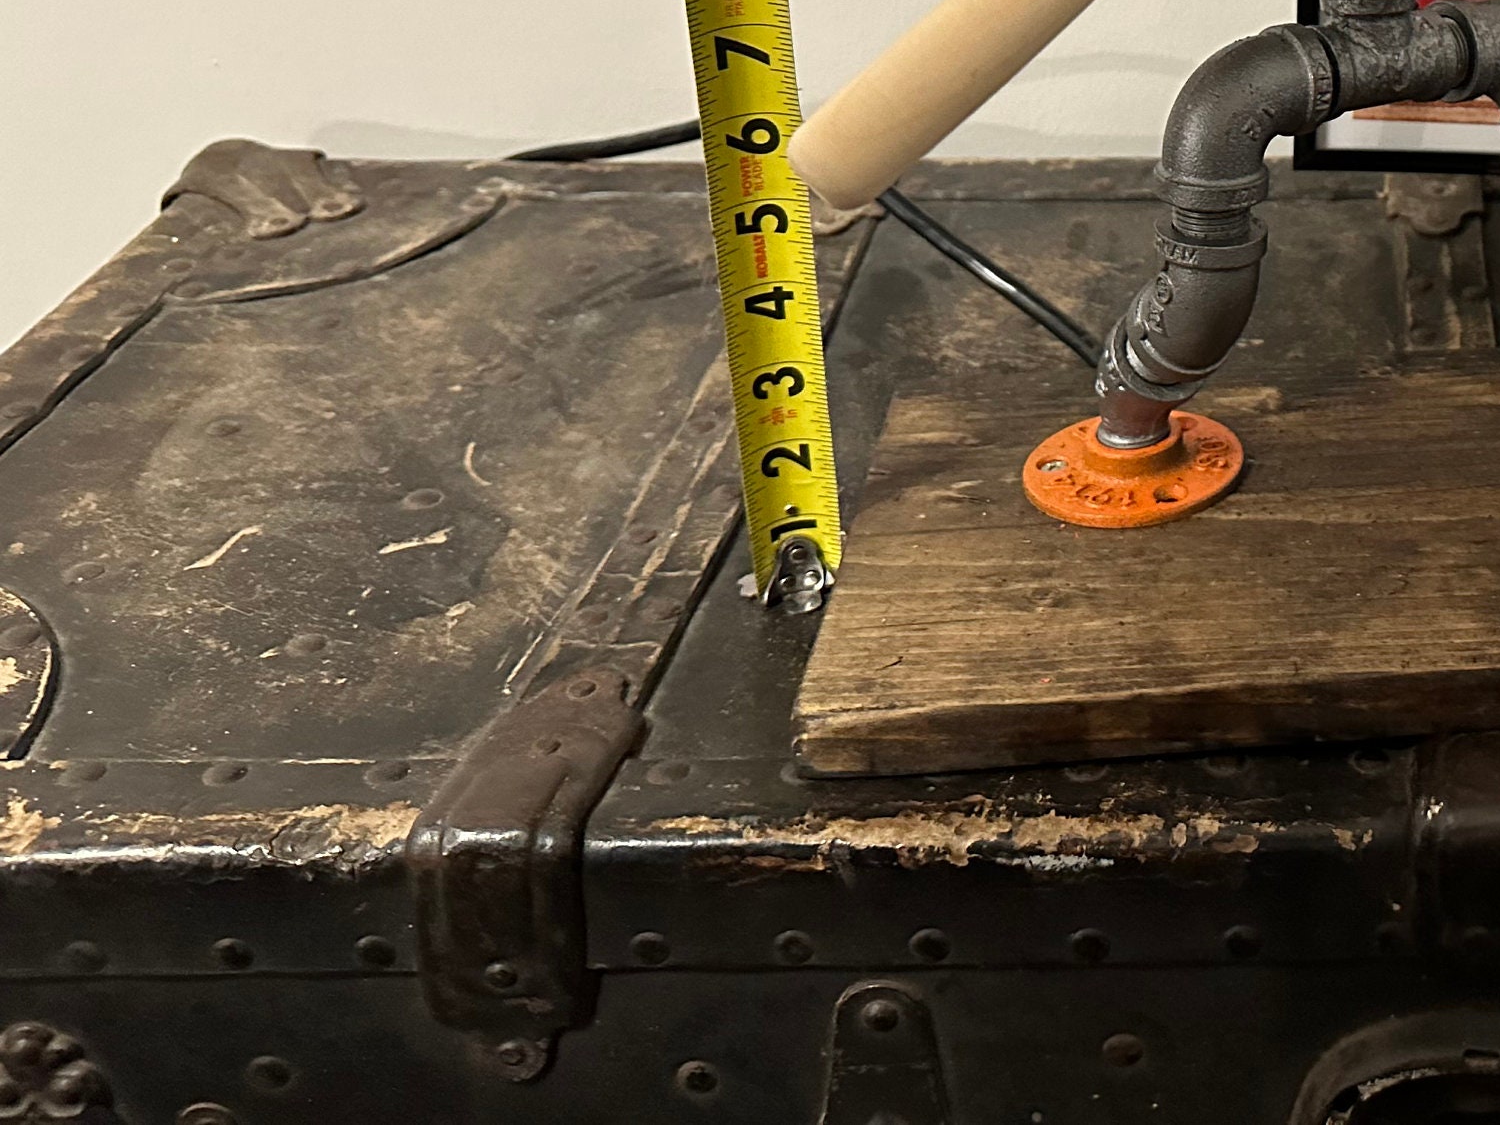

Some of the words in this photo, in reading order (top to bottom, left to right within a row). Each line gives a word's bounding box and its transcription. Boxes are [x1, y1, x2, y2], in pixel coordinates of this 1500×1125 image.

[714, 35, 771, 72] 7
[725, 118, 780, 155] 6
[740, 156, 753, 198] POWER
[735, 203, 789, 235] 5
[752, 234, 767, 279] KOBALT
[745, 286, 794, 320] 4
[753, 366, 805, 399] 3
[761, 443, 812, 478] 2
[771, 519, 817, 542] 1
